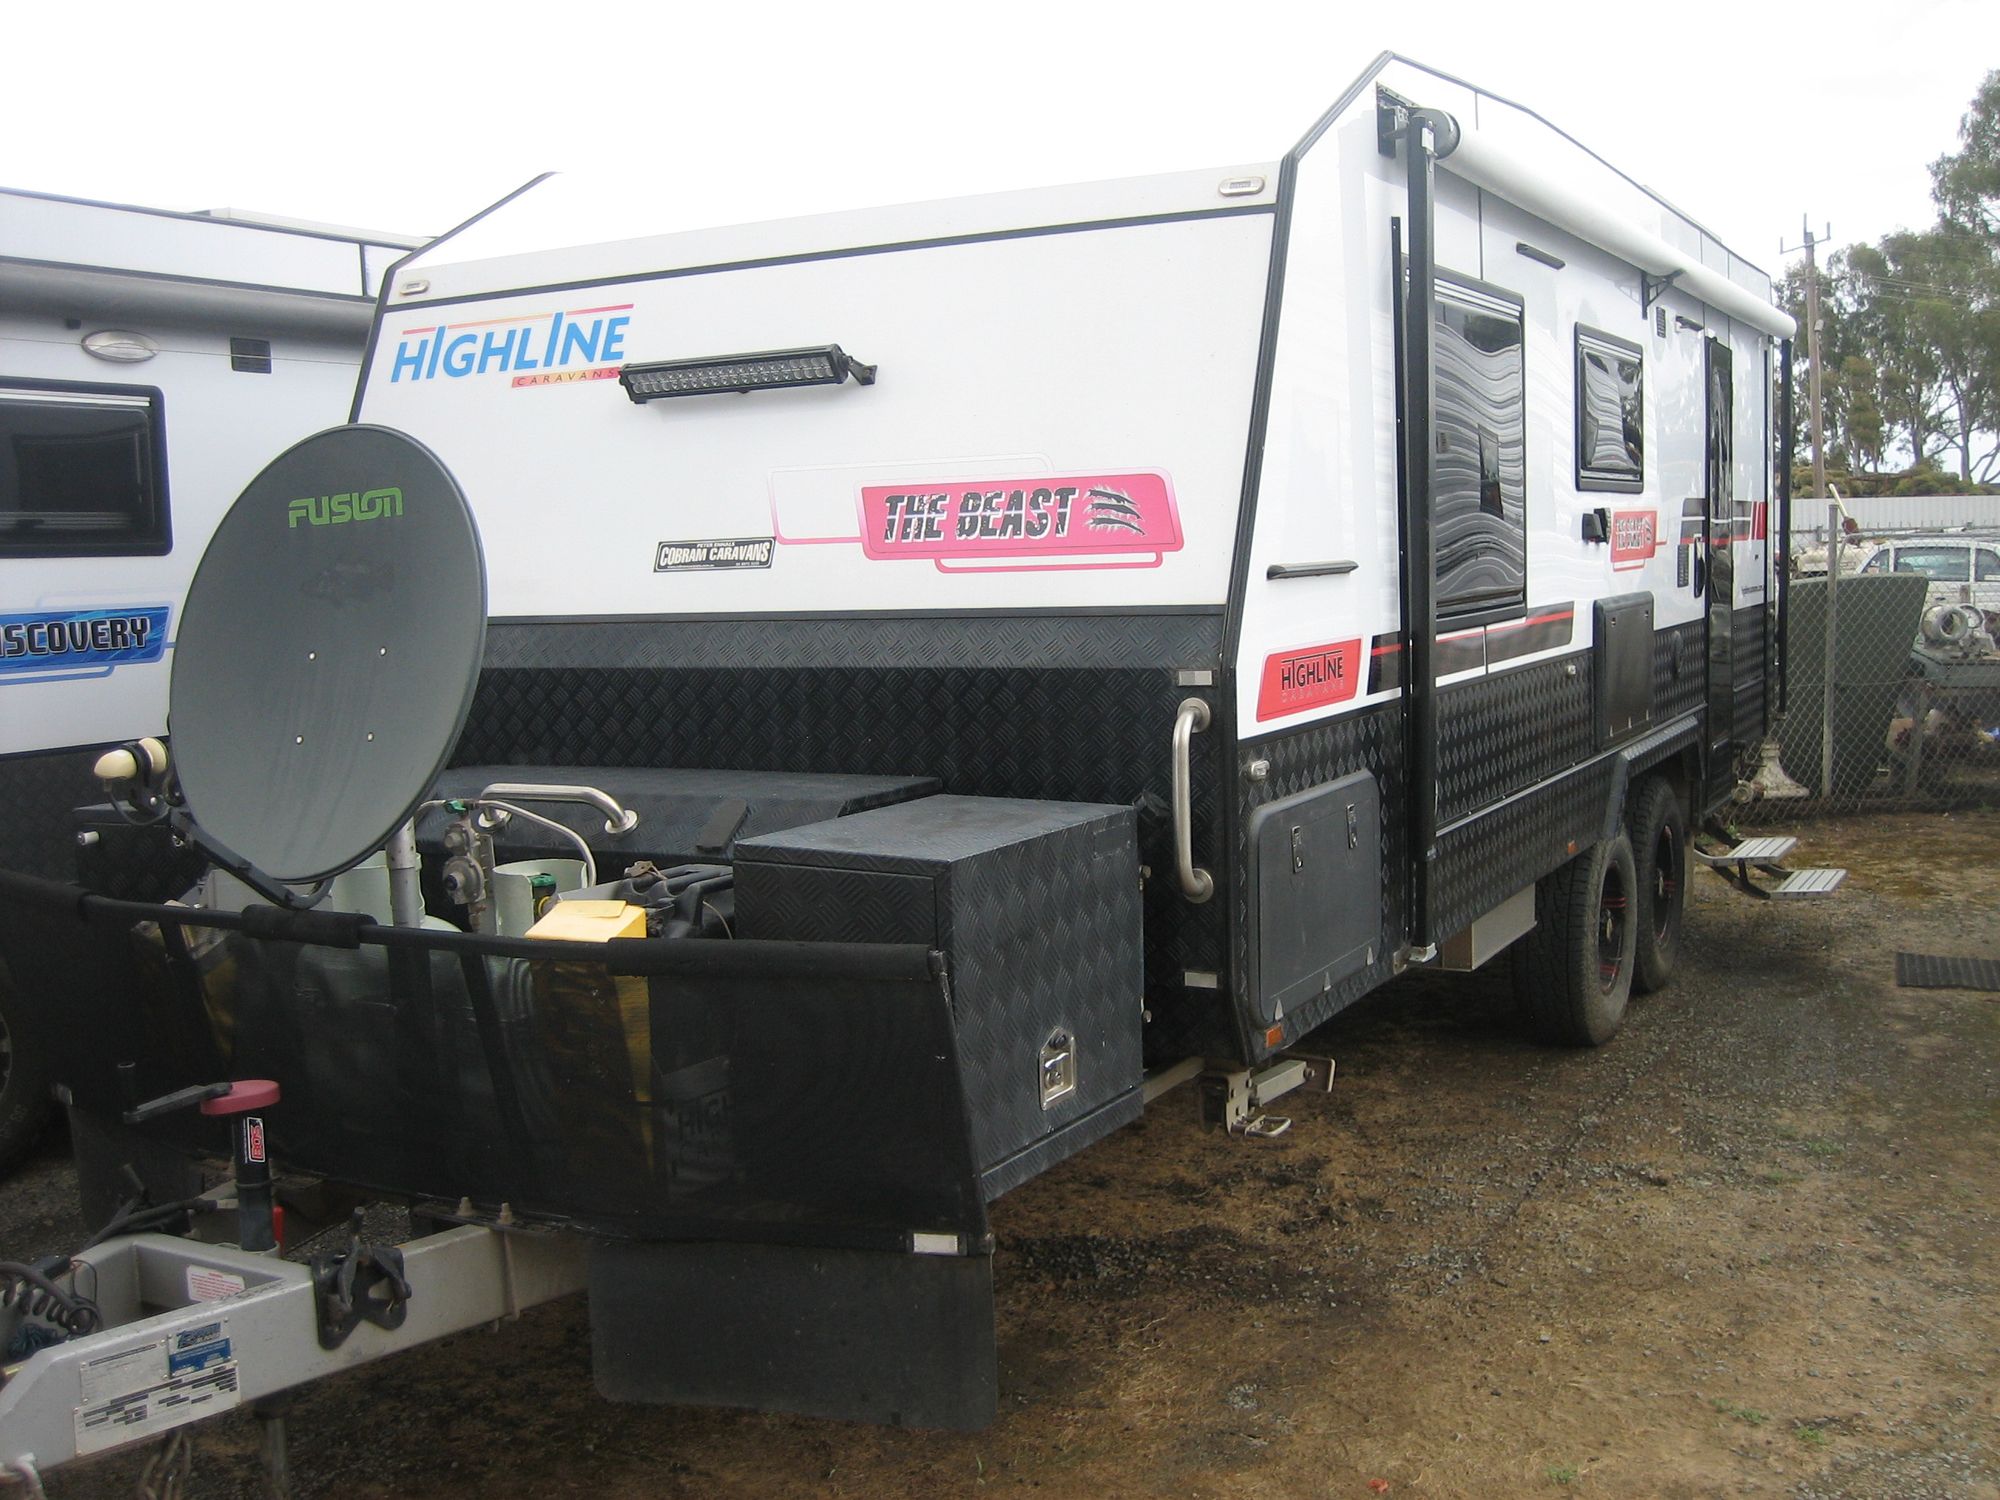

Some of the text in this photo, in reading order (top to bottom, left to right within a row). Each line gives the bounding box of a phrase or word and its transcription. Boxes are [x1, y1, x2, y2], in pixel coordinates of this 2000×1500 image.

[390, 312, 631, 383] HIGHLINE
[517, 369, 619, 387] CARAVANS
[288, 486, 404, 528] FUSION
[884, 486, 1080, 544] THE BEAST
[660, 542, 770, 566] COBRAM CARAVANS
[1281, 653, 1344, 691] HIGHLINE
